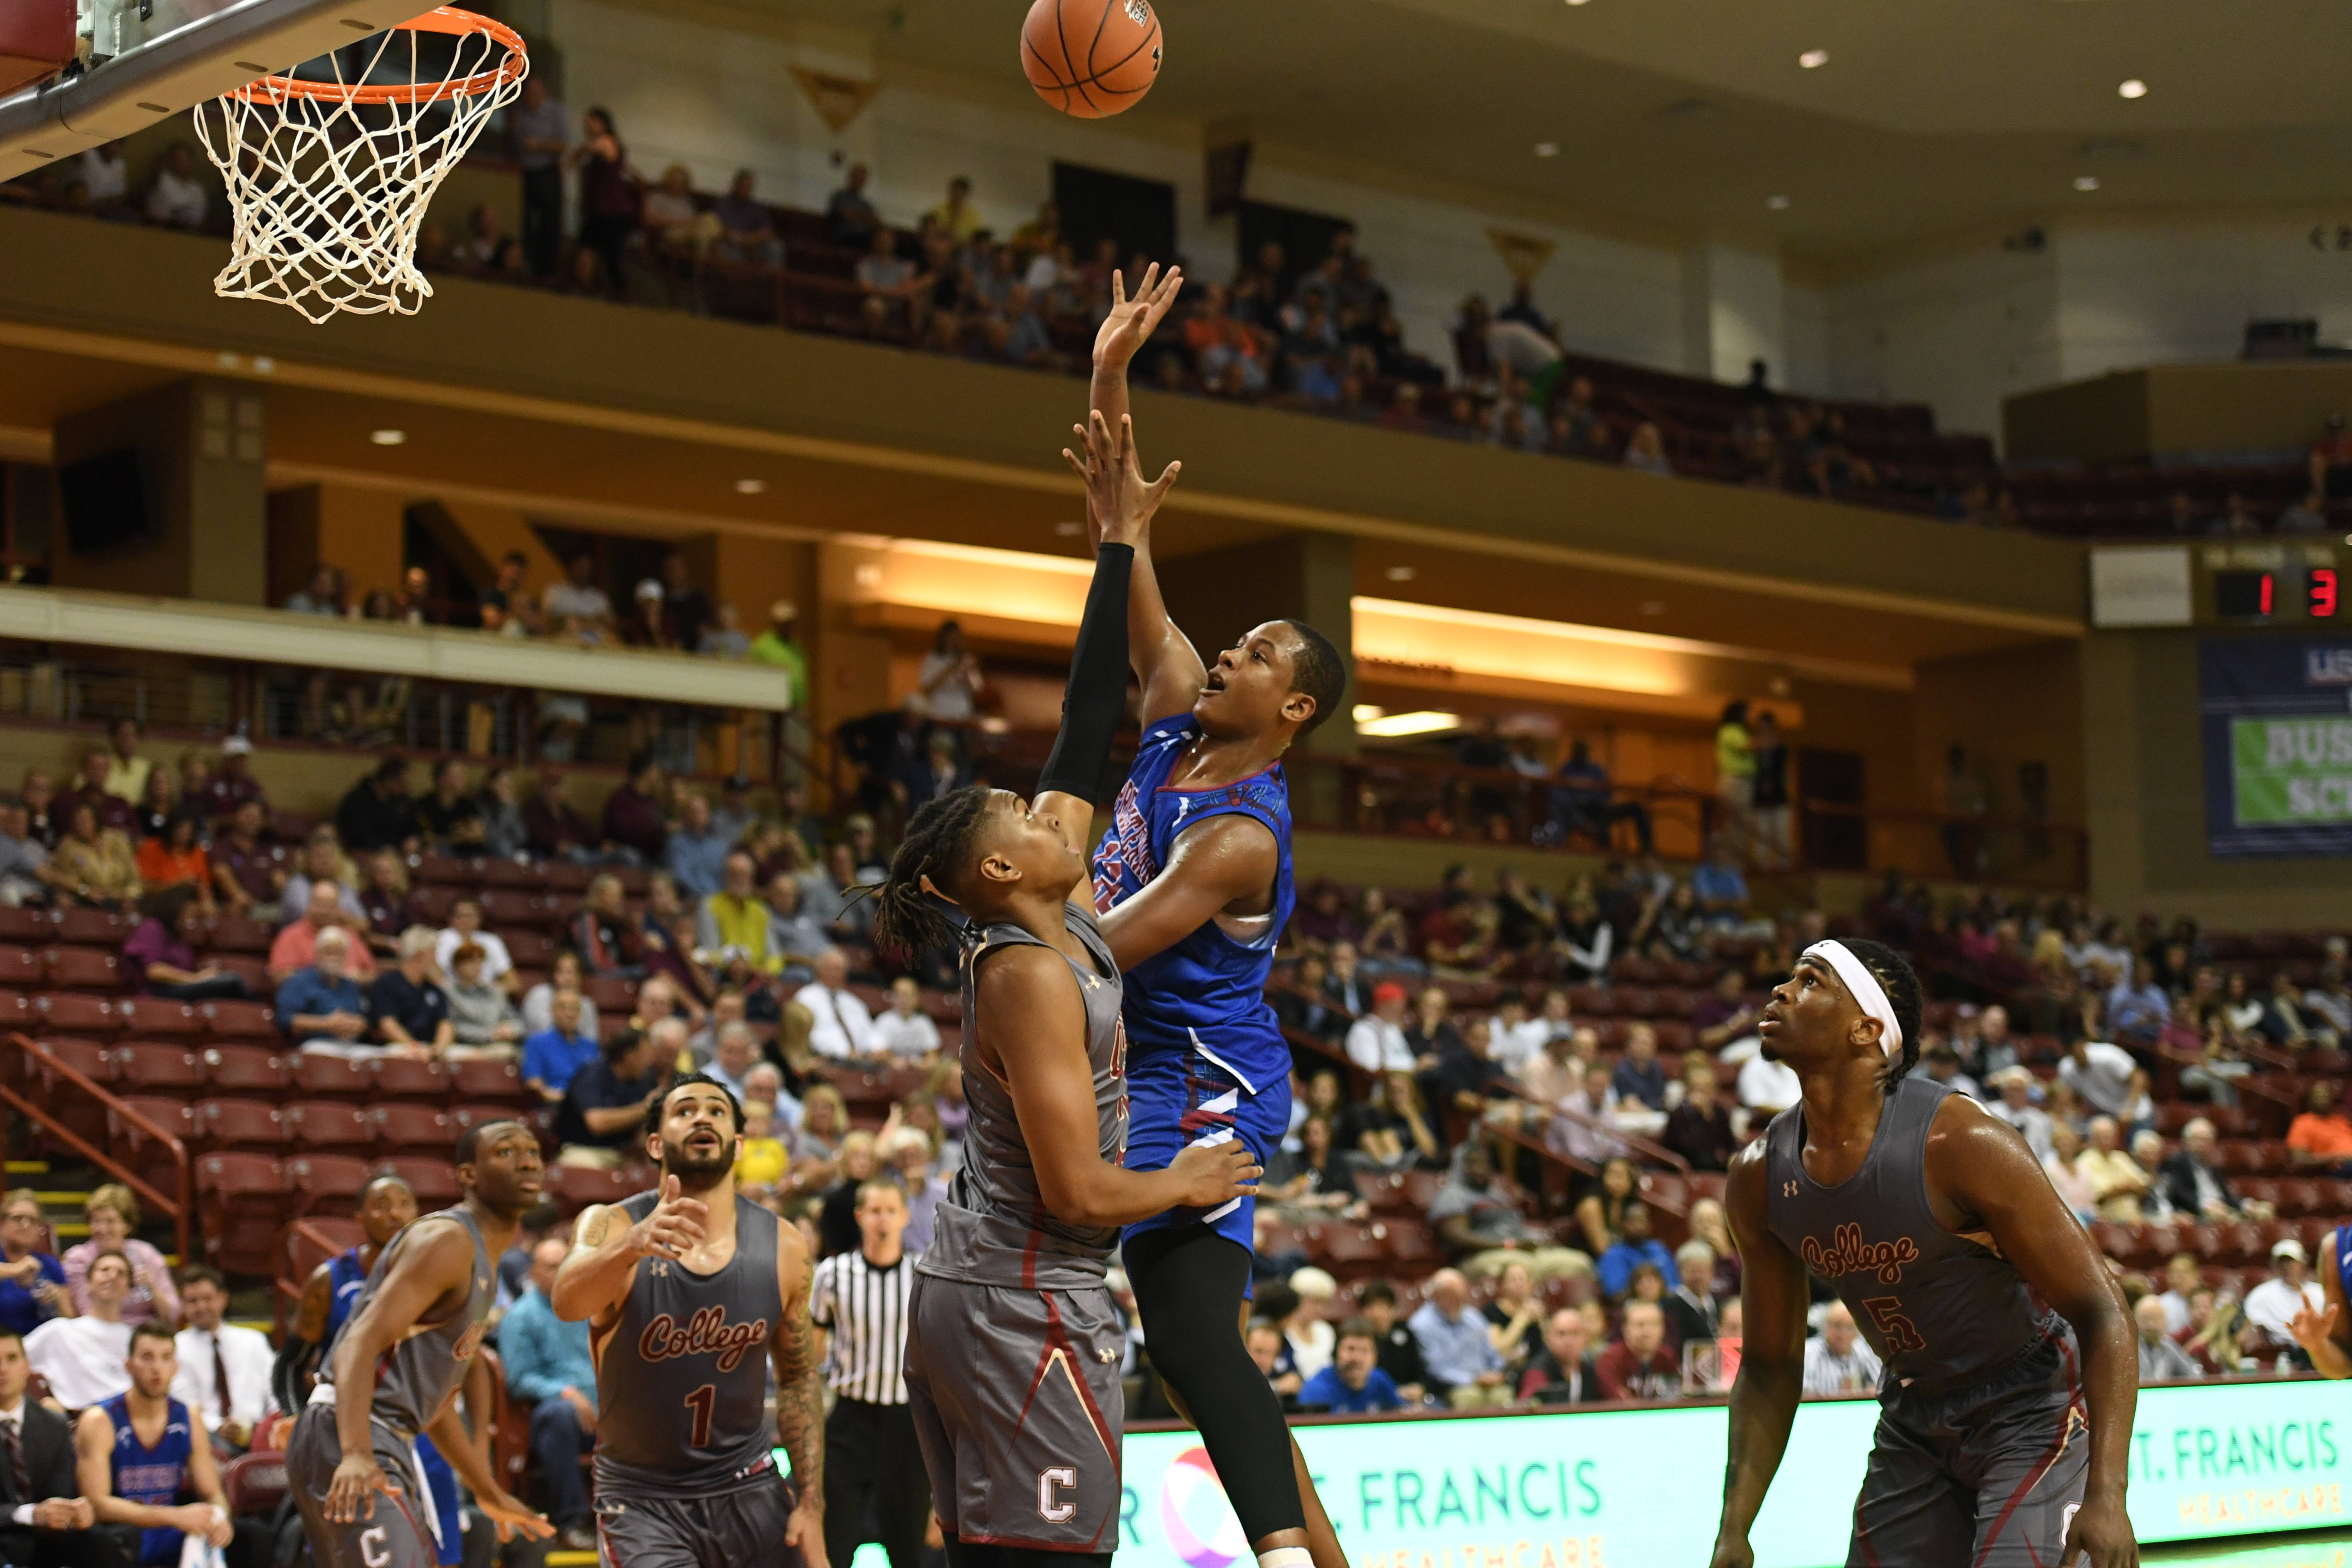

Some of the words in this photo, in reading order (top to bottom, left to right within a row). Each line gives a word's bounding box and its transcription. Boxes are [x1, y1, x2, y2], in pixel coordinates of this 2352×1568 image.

[2259, 574, 2273, 616] 1
[2310, 569, 2337, 616] 3
[2289, 778, 2352, 814] SC
[1801, 1222, 1919, 1284] College
[639, 1305, 768, 1373] College
[1862, 1296, 1926, 1354] 5
[684, 1384, 716, 1448] 1
[2128, 1431, 2165, 1482] T.
[2174, 1420, 2338, 1479] FRANCIS
[1038, 1466, 1077, 1524] C
[1360, 1459, 1601, 1530] FRANCIS
[2178, 1483, 2341, 1525] HEALTHCARE
[359, 1525, 391, 1568] C
